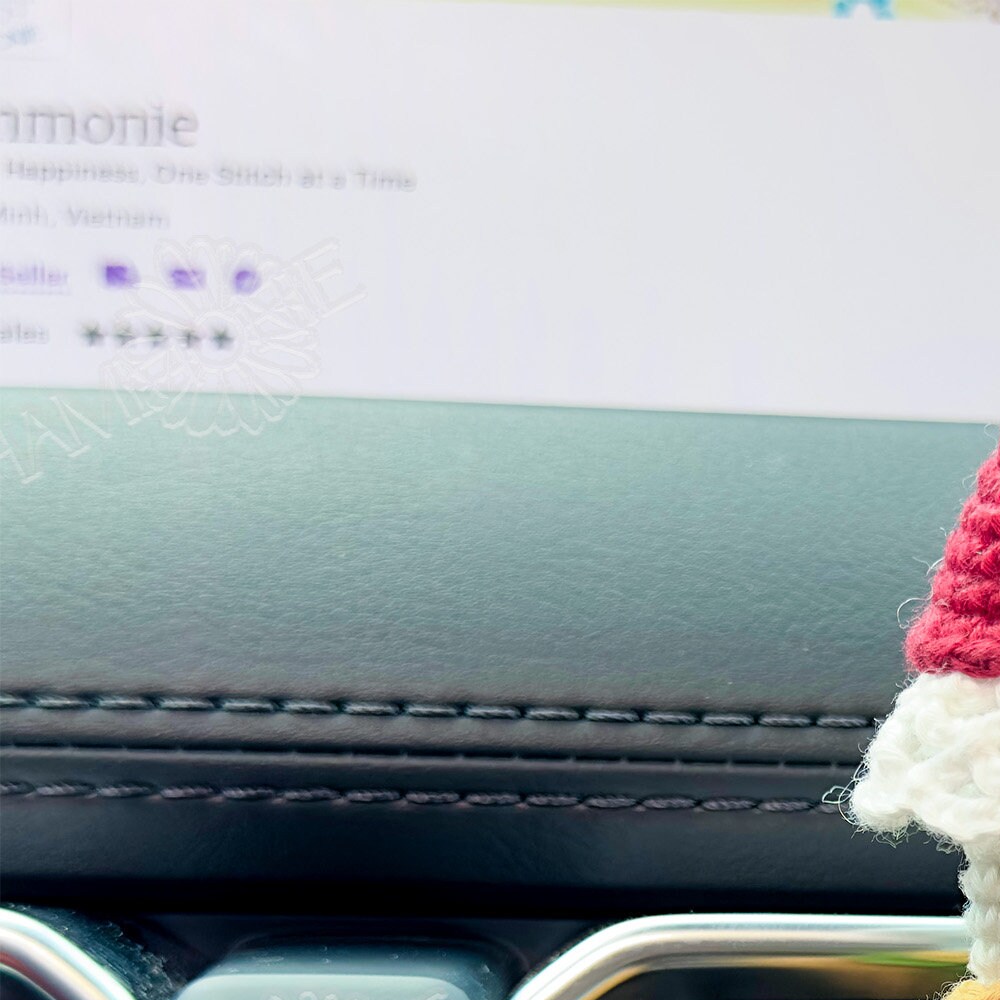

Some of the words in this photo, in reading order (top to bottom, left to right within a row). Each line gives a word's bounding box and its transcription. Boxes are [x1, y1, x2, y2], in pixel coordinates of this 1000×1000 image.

[152, 163, 210, 185] One
[216, 162, 292, 187] Stitch
[353, 165, 418, 193] Time
[66, 206, 170, 230] Vietnam
